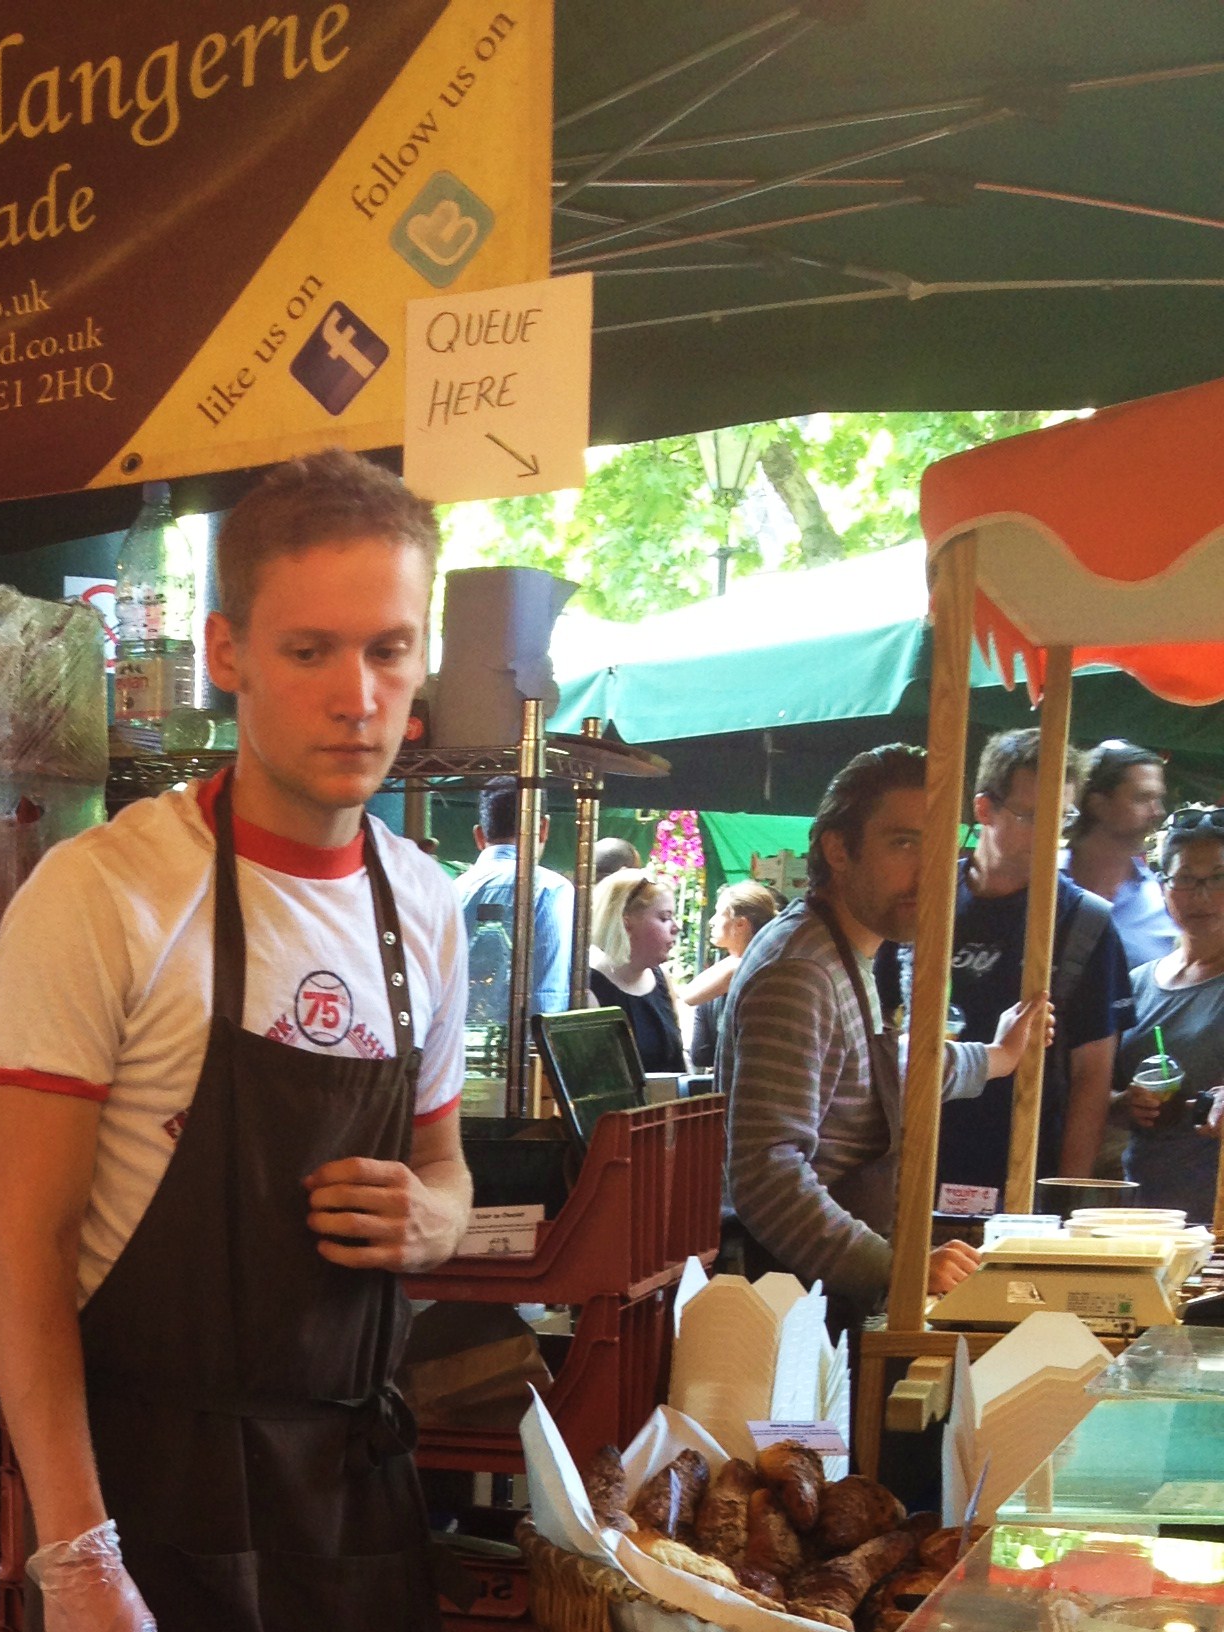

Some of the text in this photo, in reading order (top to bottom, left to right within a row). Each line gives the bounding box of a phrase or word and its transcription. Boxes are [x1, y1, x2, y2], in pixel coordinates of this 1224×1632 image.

[351, 12, 517, 220] follow us on
[196, 274, 325, 429] like us on
[425, 307, 543, 353] QUEUE
[37, 363, 116, 407] 2HQ
[427, 372, 519, 427] HERE
[303, 990, 341, 1029] 75
